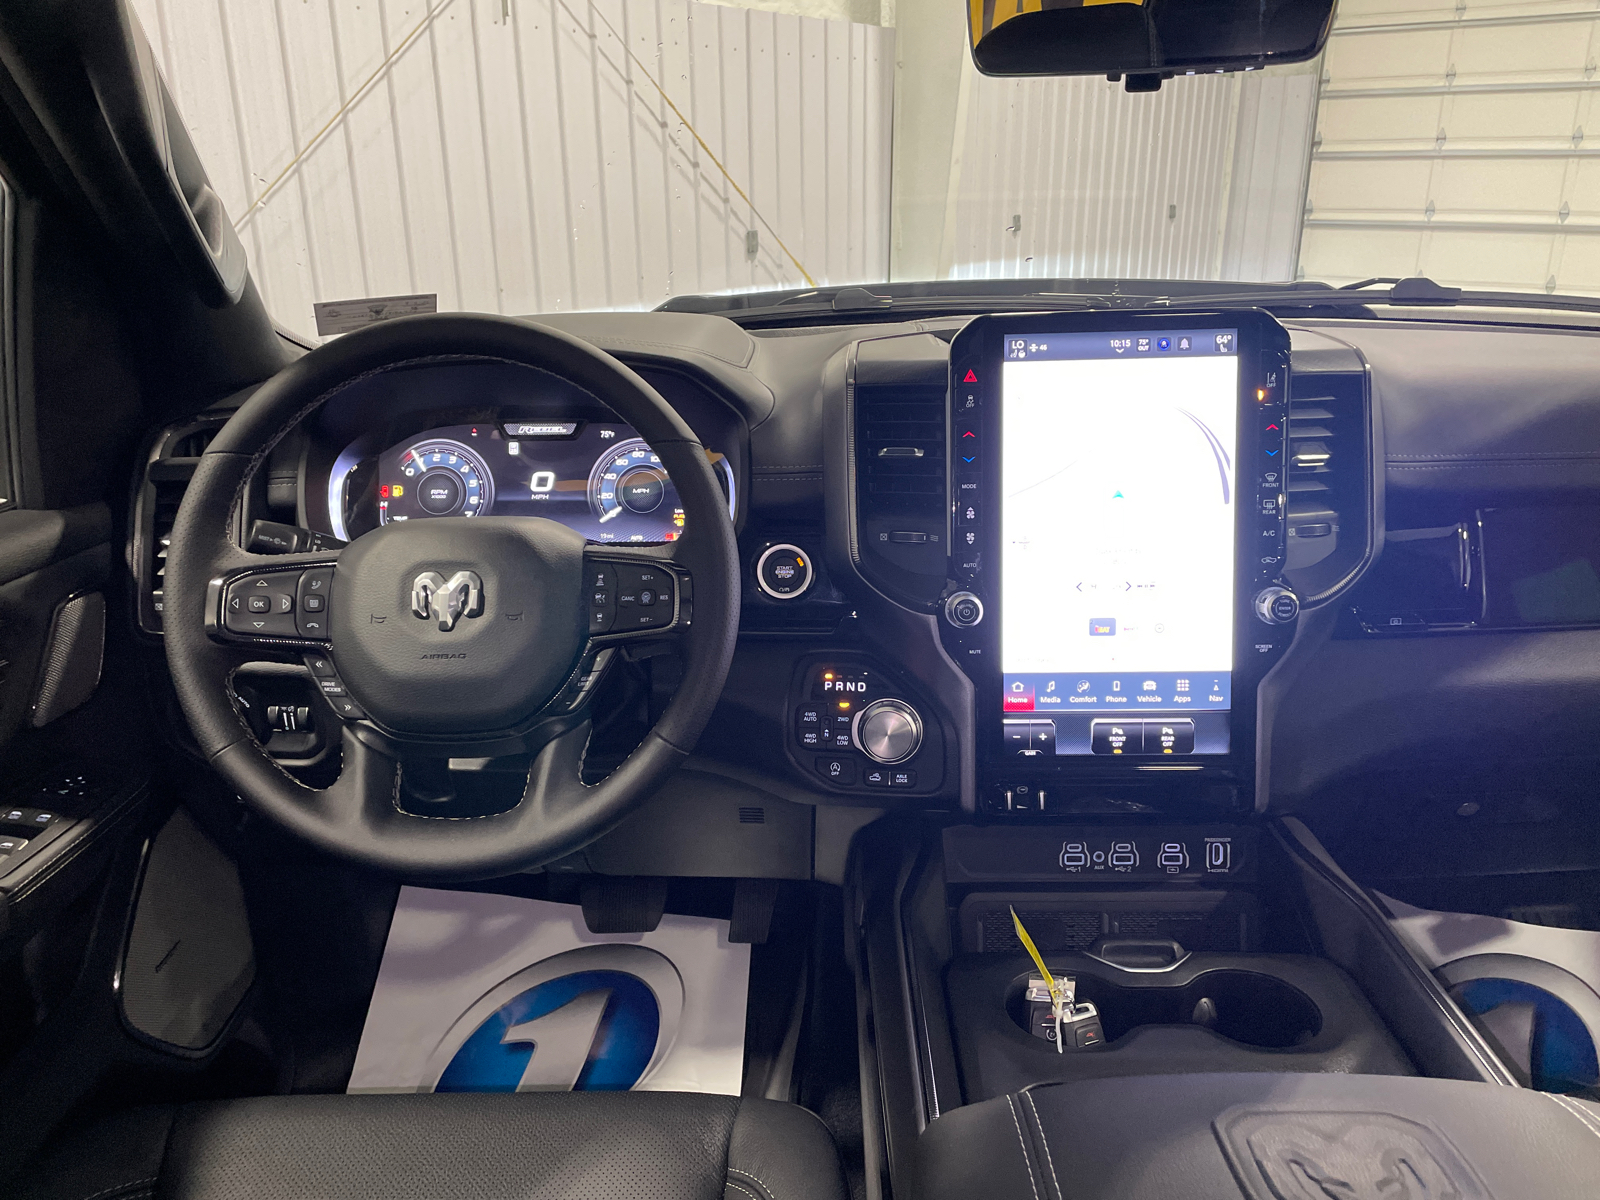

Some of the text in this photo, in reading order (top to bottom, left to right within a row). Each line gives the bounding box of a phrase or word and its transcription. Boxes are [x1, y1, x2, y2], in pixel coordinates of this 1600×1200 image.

[1012, 340, 1024, 349] LO
[1110, 339, 1131, 348] 10:15
[432, 454, 441, 462] 2
[448, 456, 457, 464] 3
[405, 468, 414, 476] 0
[460, 465, 470, 473] 4
[468, 480, 478, 488] 5
[530, 471, 555, 492] 0
[469, 496, 478, 504] 6
[1174, 696, 1192, 704] Apps
[500, 987, 614, 1092] 1
